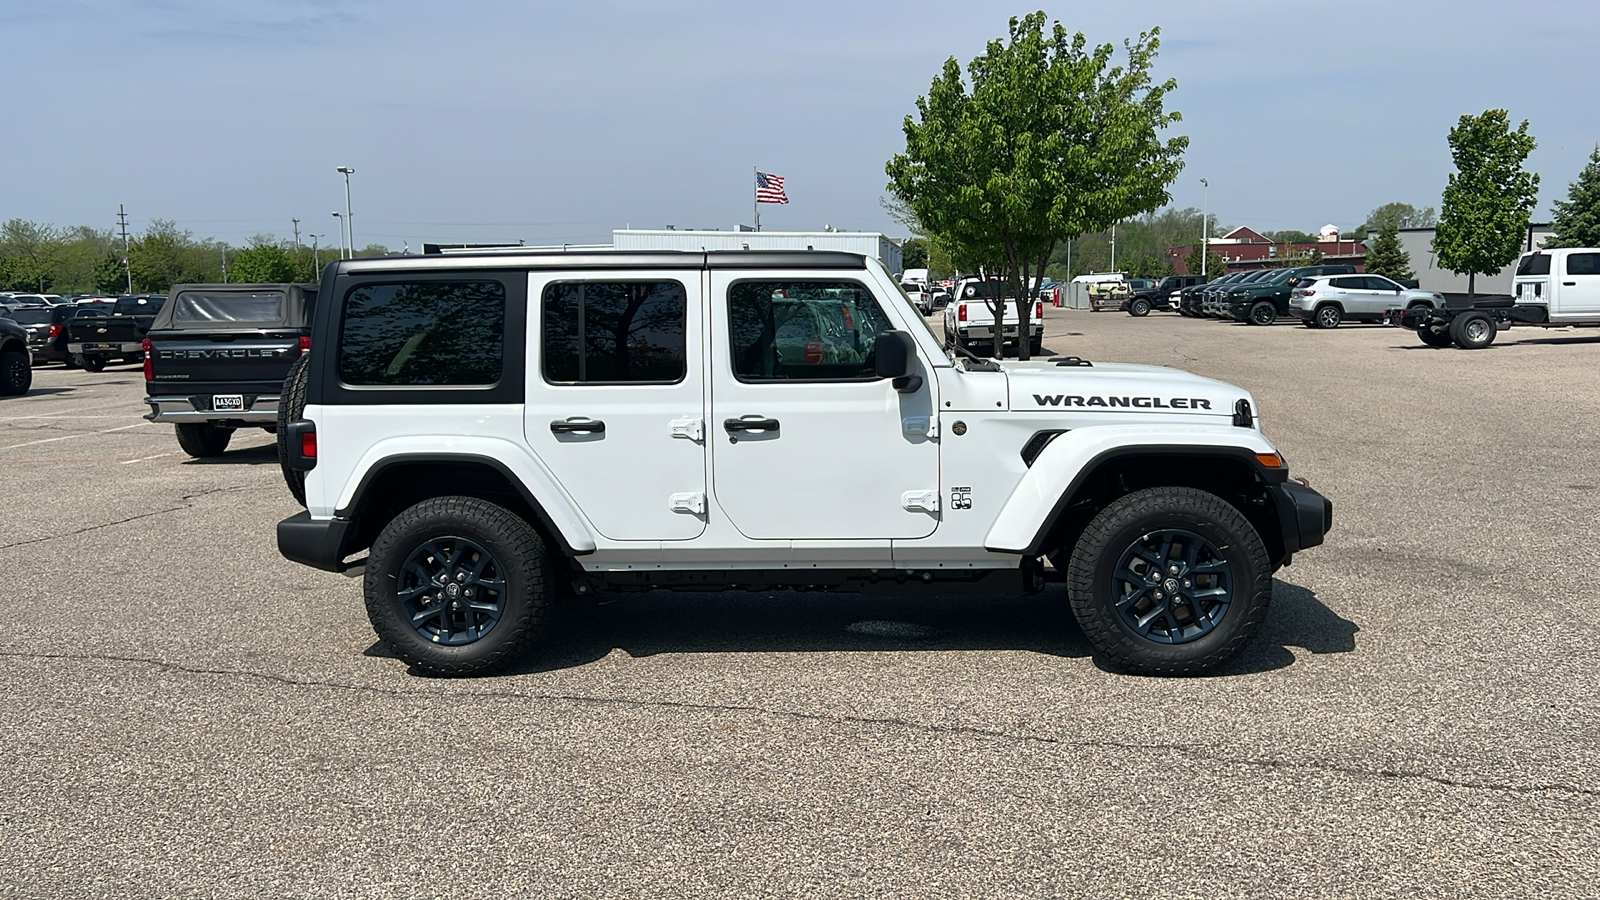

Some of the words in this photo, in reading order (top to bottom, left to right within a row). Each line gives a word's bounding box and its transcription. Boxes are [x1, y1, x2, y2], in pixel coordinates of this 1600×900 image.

[160, 349, 288, 359] CHEVROLET
[216, 398, 241, 406] AA3GXD
[1032, 394, 1213, 410] WRANGLER
[951, 492, 972, 510] 85
